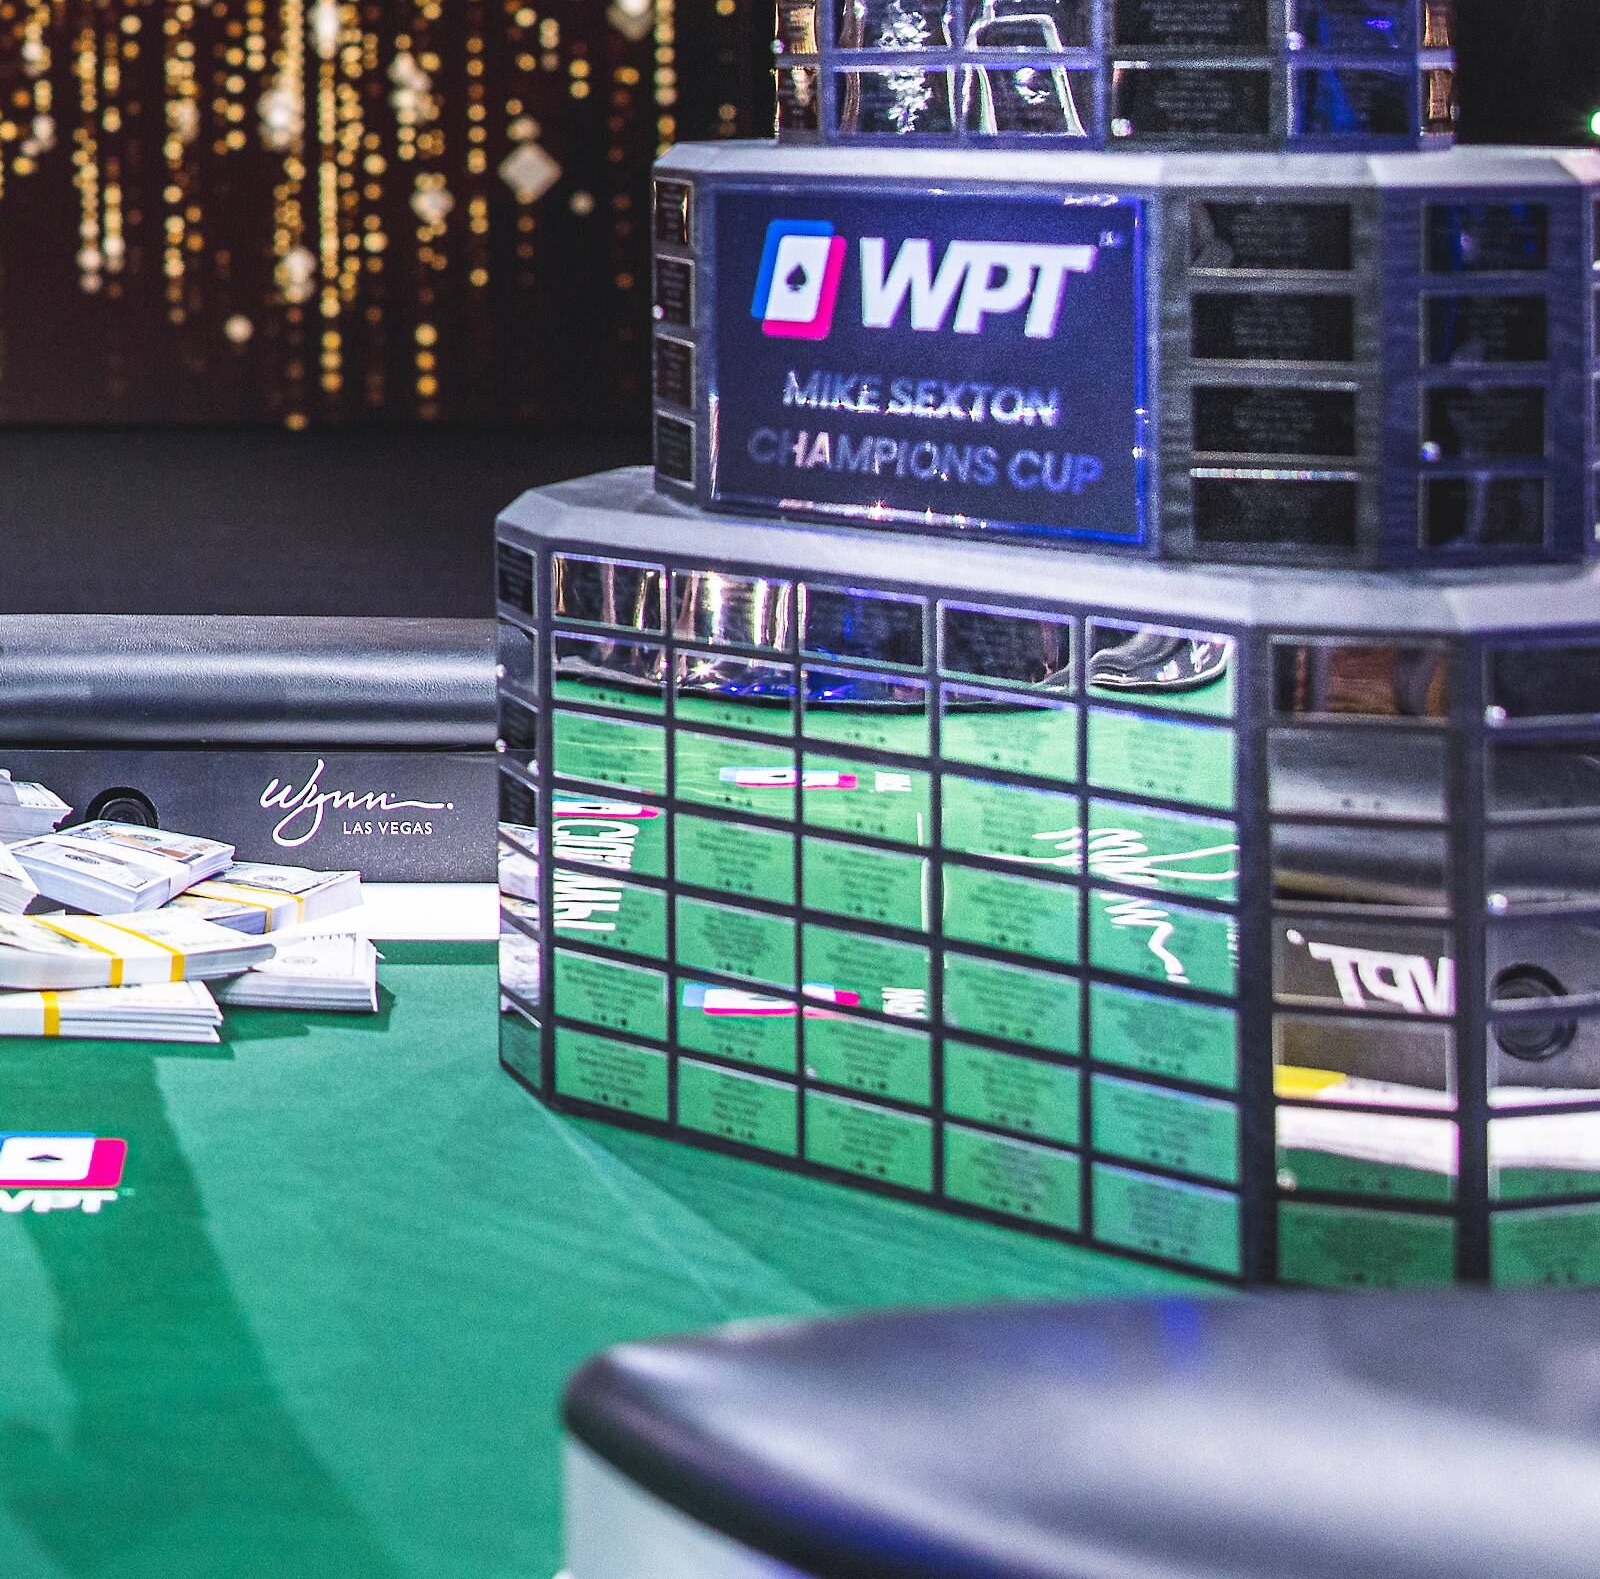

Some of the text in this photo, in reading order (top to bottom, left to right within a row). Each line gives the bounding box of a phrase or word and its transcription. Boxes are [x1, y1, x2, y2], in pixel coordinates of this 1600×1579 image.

[858, 236, 1098, 339] WPT
[782, 369, 1062, 427] MIKE SEXTON
[747, 426, 1104, 495] CHAMPIONS CUP
[342, 821, 433, 835] LAS VEGAS
